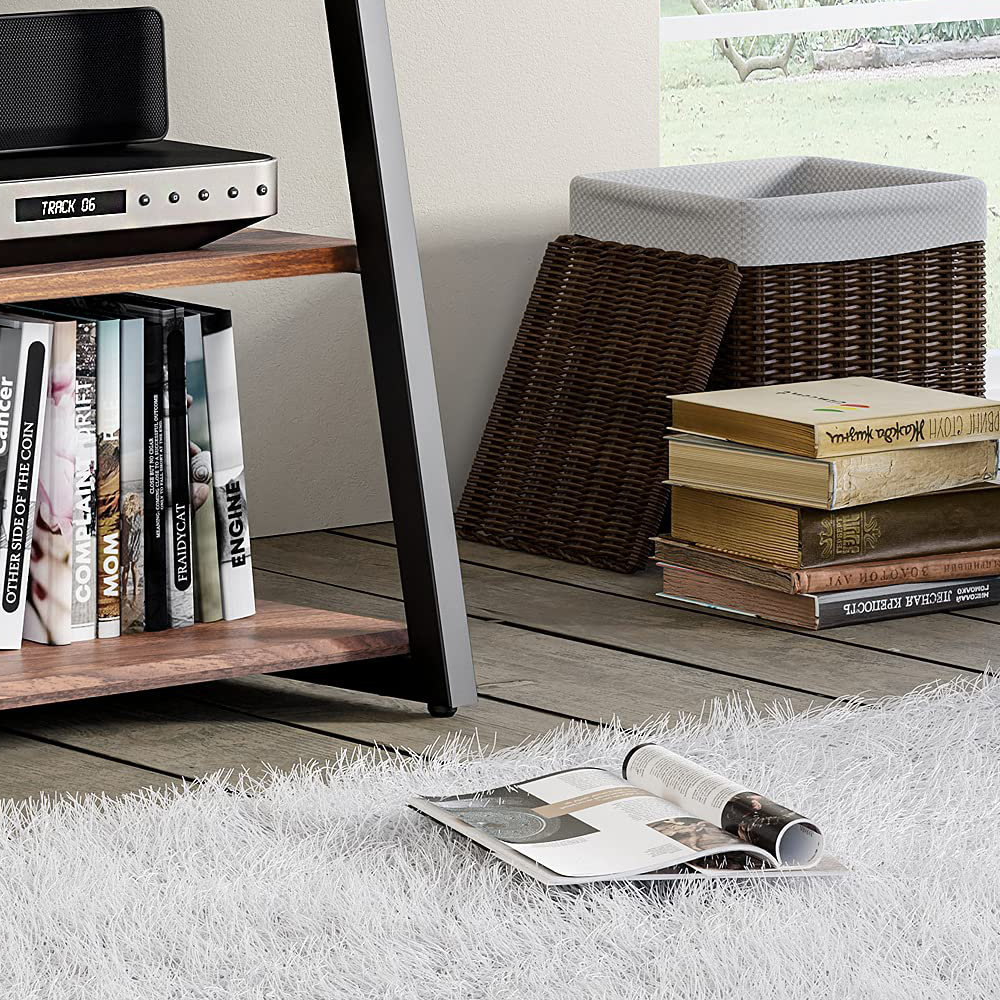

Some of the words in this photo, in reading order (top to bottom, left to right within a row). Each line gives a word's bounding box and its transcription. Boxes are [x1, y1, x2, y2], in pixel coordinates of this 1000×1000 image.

[41, 199, 77, 216] TRACK
[80, 197, 96, 213] 06
[825, 425, 874, 444] жизни
[875, 418, 925, 443] Жажда
[928, 415, 964, 440] СТОУН
[20, 421, 34, 461] COIN
[149, 456, 155, 464] NO
[17, 462, 30, 493] THE
[14, 495, 27, 515] OF
[11, 517, 25, 551] SIDE
[225, 478, 246, 568] ENGINE
[175, 503, 188, 582] FRAIDYCAT
[103, 532, 120, 597] MOM
[5, 552, 20, 604] OTHER
[826, 574, 853, 587] ЛУГ
[842, 597, 903, 615] КРЕПОСТЬ
[905, 590, 953, 608] ЛЕСНАЯ
